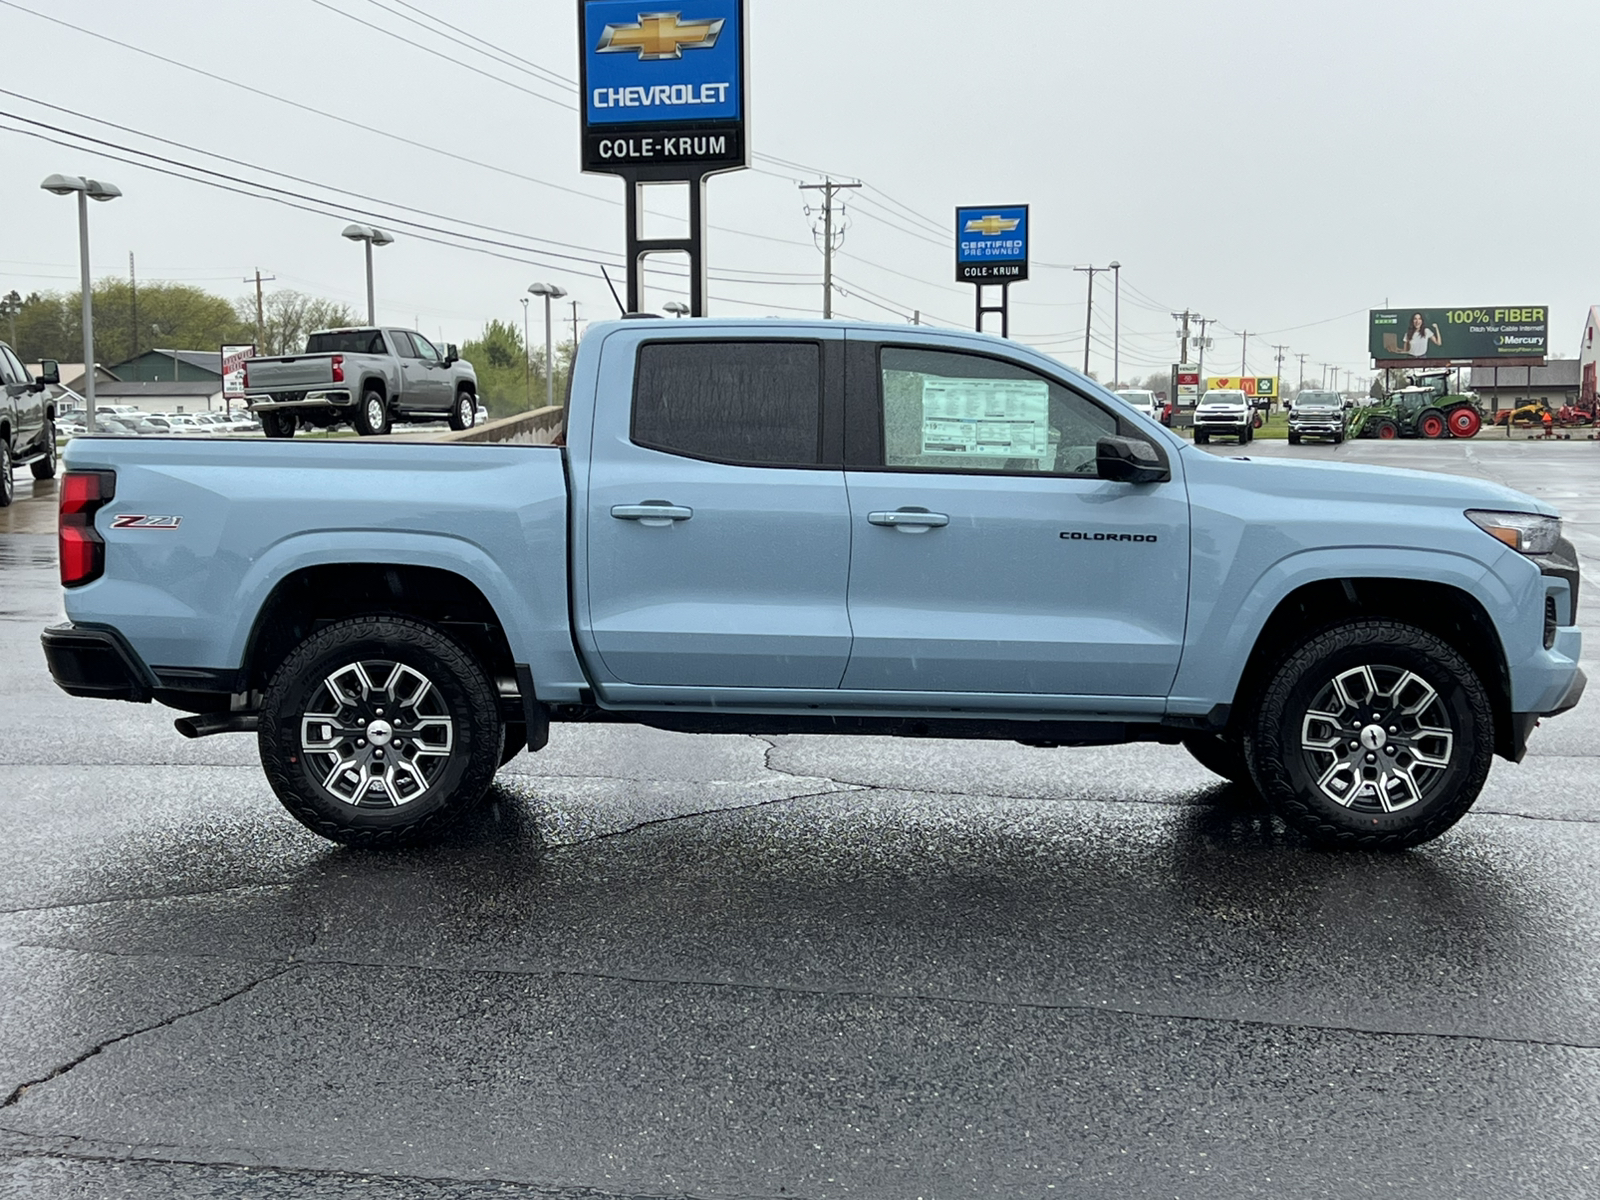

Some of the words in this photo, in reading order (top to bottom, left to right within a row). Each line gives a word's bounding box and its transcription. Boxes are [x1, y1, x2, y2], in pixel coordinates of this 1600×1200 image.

[593, 82, 729, 108] CHEVROLET
[599, 136, 726, 158] COLE-KRUM
[961, 240, 1022, 249] CERTIFIED
[964, 248, 1020, 256] PRE-OWNED
[964, 266, 1019, 277] COLE-KRUM
[1446, 310, 1490, 324] 100%
[1494, 308, 1544, 323] FIBER
[1504, 335, 1544, 346] Mercury
[110, 514, 183, 530] Z71
[1059, 531, 1158, 543] COLORADO
